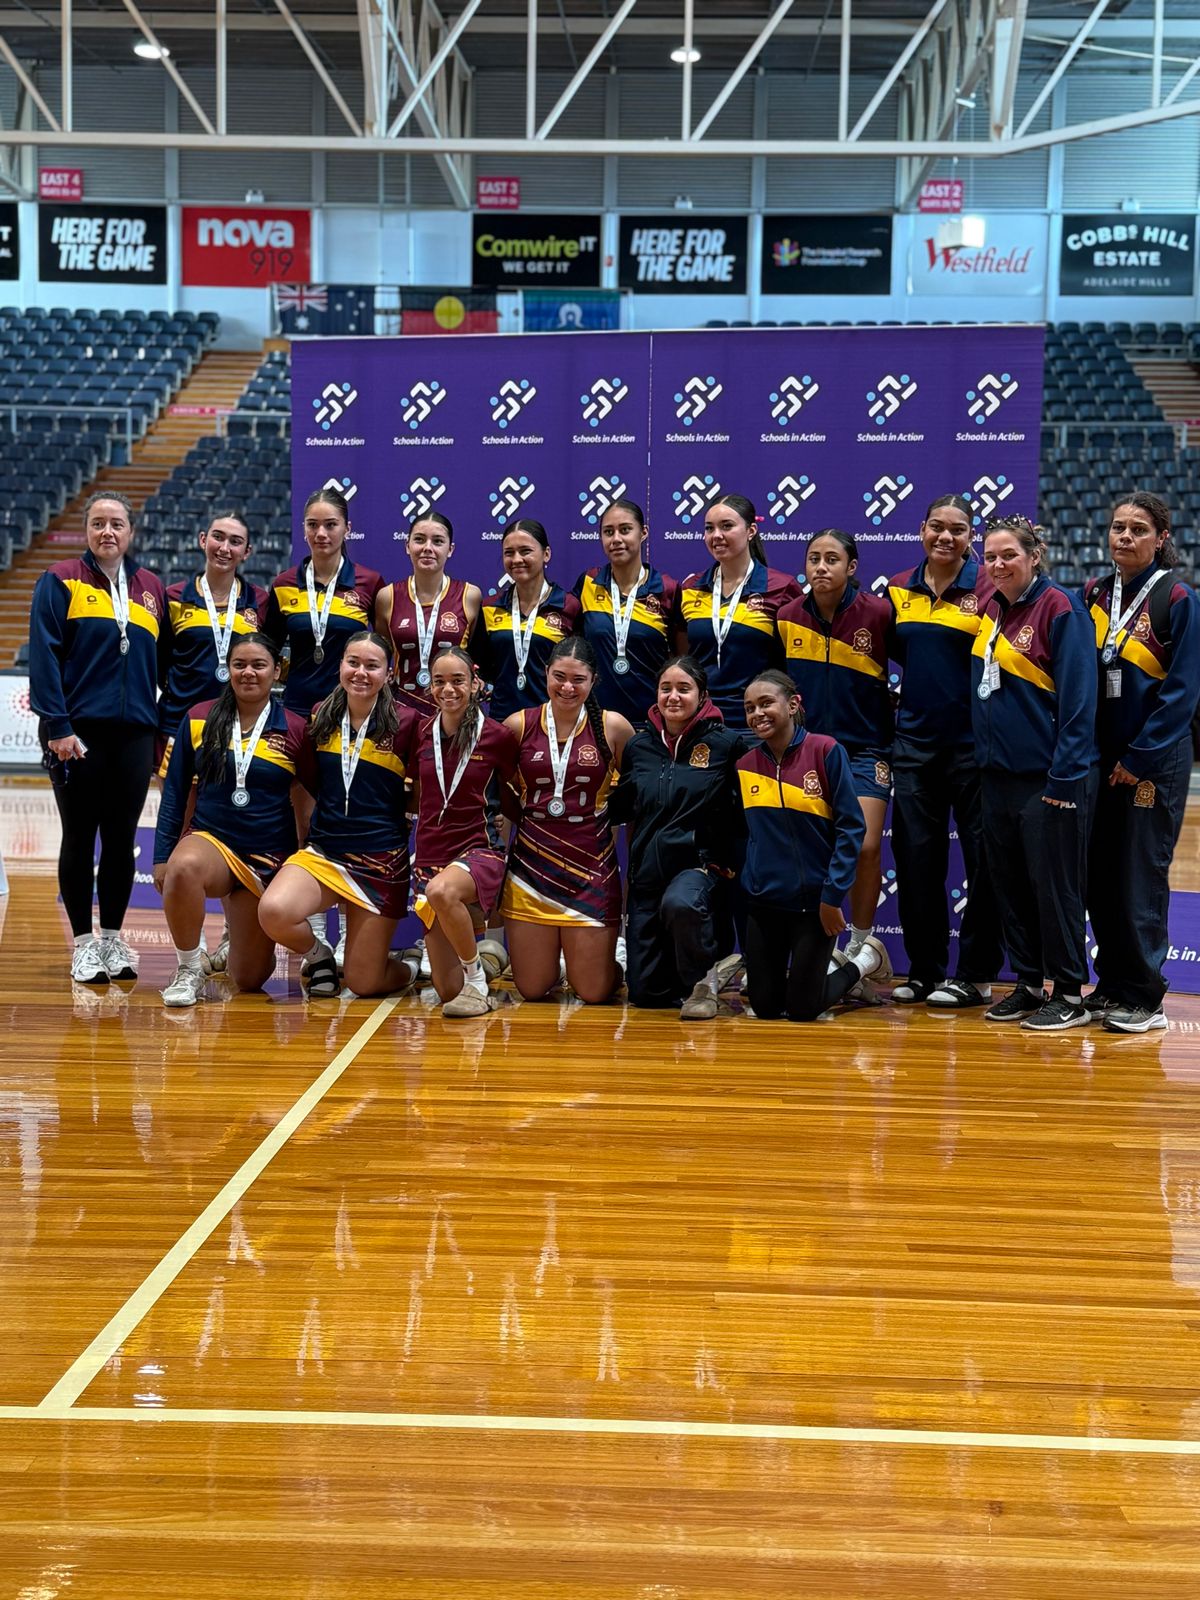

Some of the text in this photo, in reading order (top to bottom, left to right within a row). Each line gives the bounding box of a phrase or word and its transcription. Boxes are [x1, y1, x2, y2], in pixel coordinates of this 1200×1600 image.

[40, 172, 81, 186] EAST 4
[479, 181, 519, 195] EAST 3
[921, 184, 962, 198] EAST 2
[51, 217, 147, 245] HERE FOR
[197, 217, 295, 248] nova
[630, 228, 727, 256] HERE FOR
[1142, 225, 1190, 252] HILL
[58, 244, 157, 272] THE GAME
[924, 237, 1034, 273] Westfield
[1093, 251, 1161, 267] ESTATE
[249, 249, 294, 276] 919
[502, 261, 571, 274] WE GET IT
[636, 255, 737, 282] THE GAME
[1083, 277, 1171, 288] ADELAIDE HILLS
[305, 437, 365, 446] Schools in Action
[393, 436, 454, 446] Schools in Action
[482, 435, 544, 445] Schools in Action
[572, 434, 635, 443] Schools in Action
[665, 433, 730, 442] Schools in Action
[760, 433, 826, 442] Schools in Action
[857, 432, 924, 442] Schools in Action
[956, 432, 1025, 441] Schools in Action
[345, 531, 365, 540] ction
[481, 531, 503, 540] Schoo
[571, 531, 600, 540] Schools
[664, 531, 694, 540] Schools
[694, 531, 702, 540] in
[759, 532, 813, 541] Schools in Acti
[854, 533, 920, 542] Schools in Action
[876, 924, 885, 933] in
[1181, 946, 1197, 960] in
